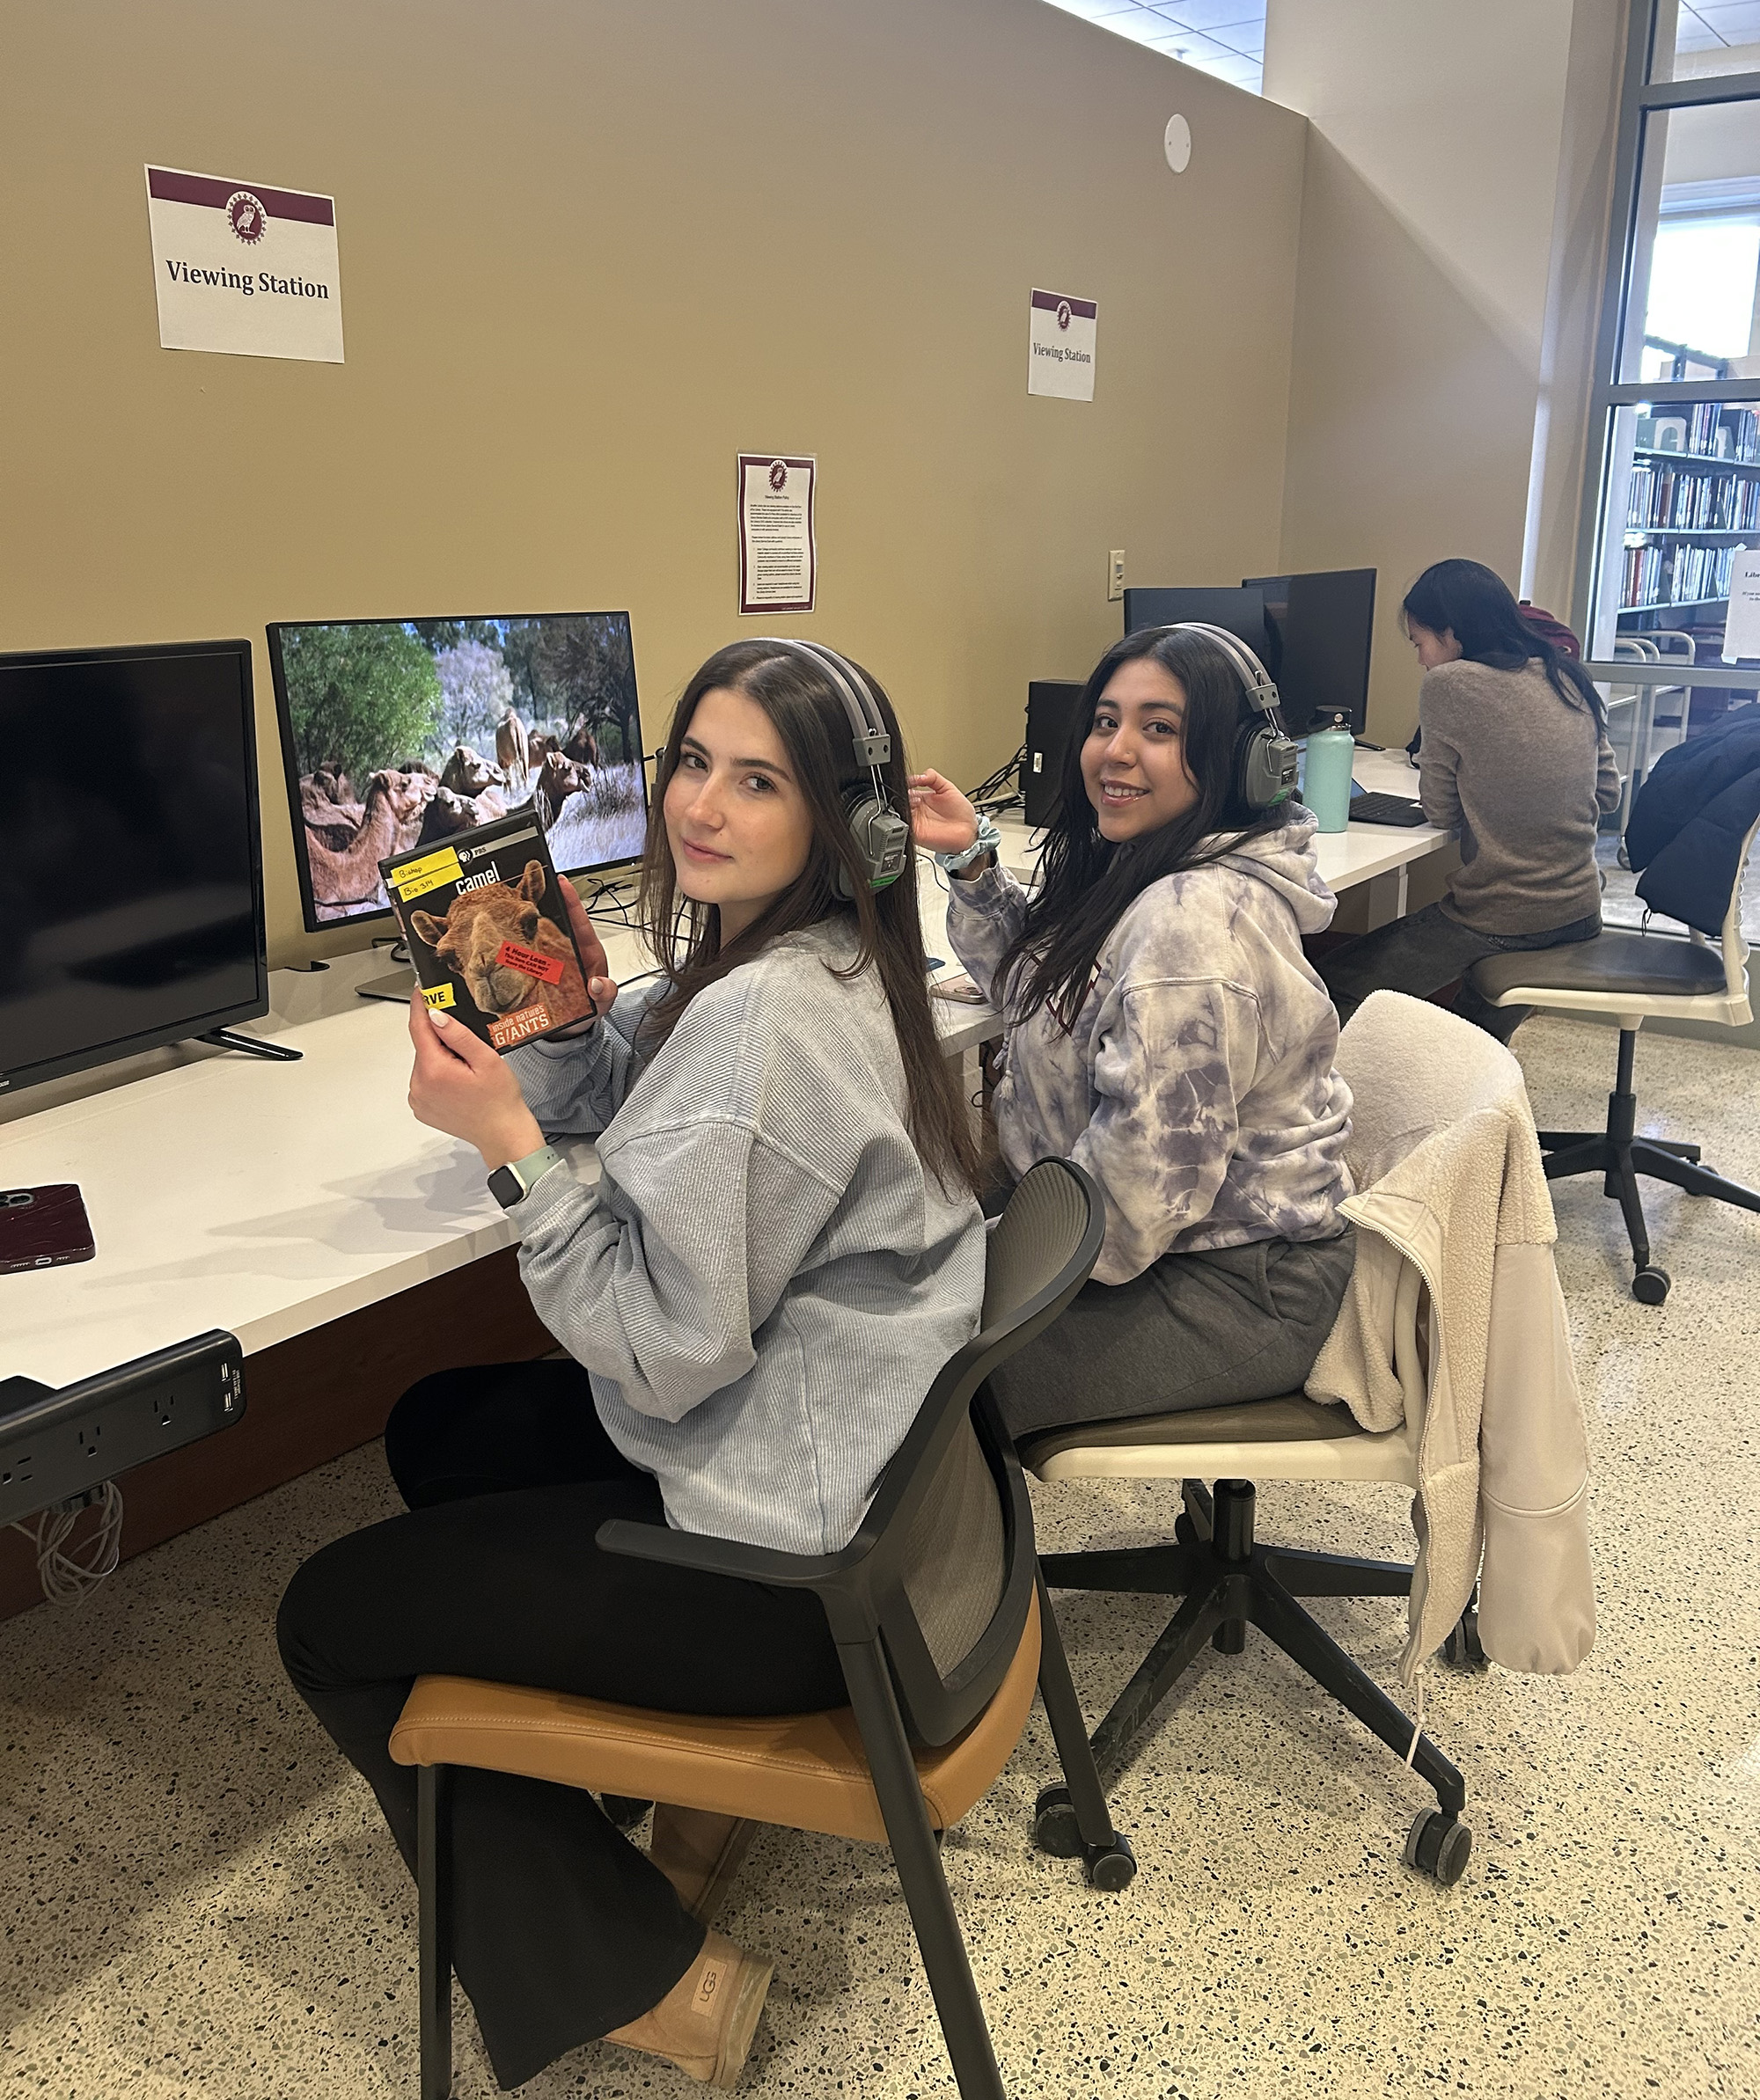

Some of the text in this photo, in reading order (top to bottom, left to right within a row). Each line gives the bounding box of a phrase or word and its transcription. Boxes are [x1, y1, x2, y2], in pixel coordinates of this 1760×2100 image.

[165, 260, 329, 299] Viewing Station
[1033, 342, 1091, 363] Viewing Station
[474, 846, 487, 856] PBS
[399, 867, 422, 878] Bishop
[455, 860, 501, 896] camel
[403, 880, 434, 896] Bio 314
[511, 948, 530, 959] Hour
[530, 955, 547, 966] Loan
[493, 1004, 545, 1033] inside nature's
[495, 1013, 550, 1046] GIANTS
[699, 1971, 717, 2003] UGG
